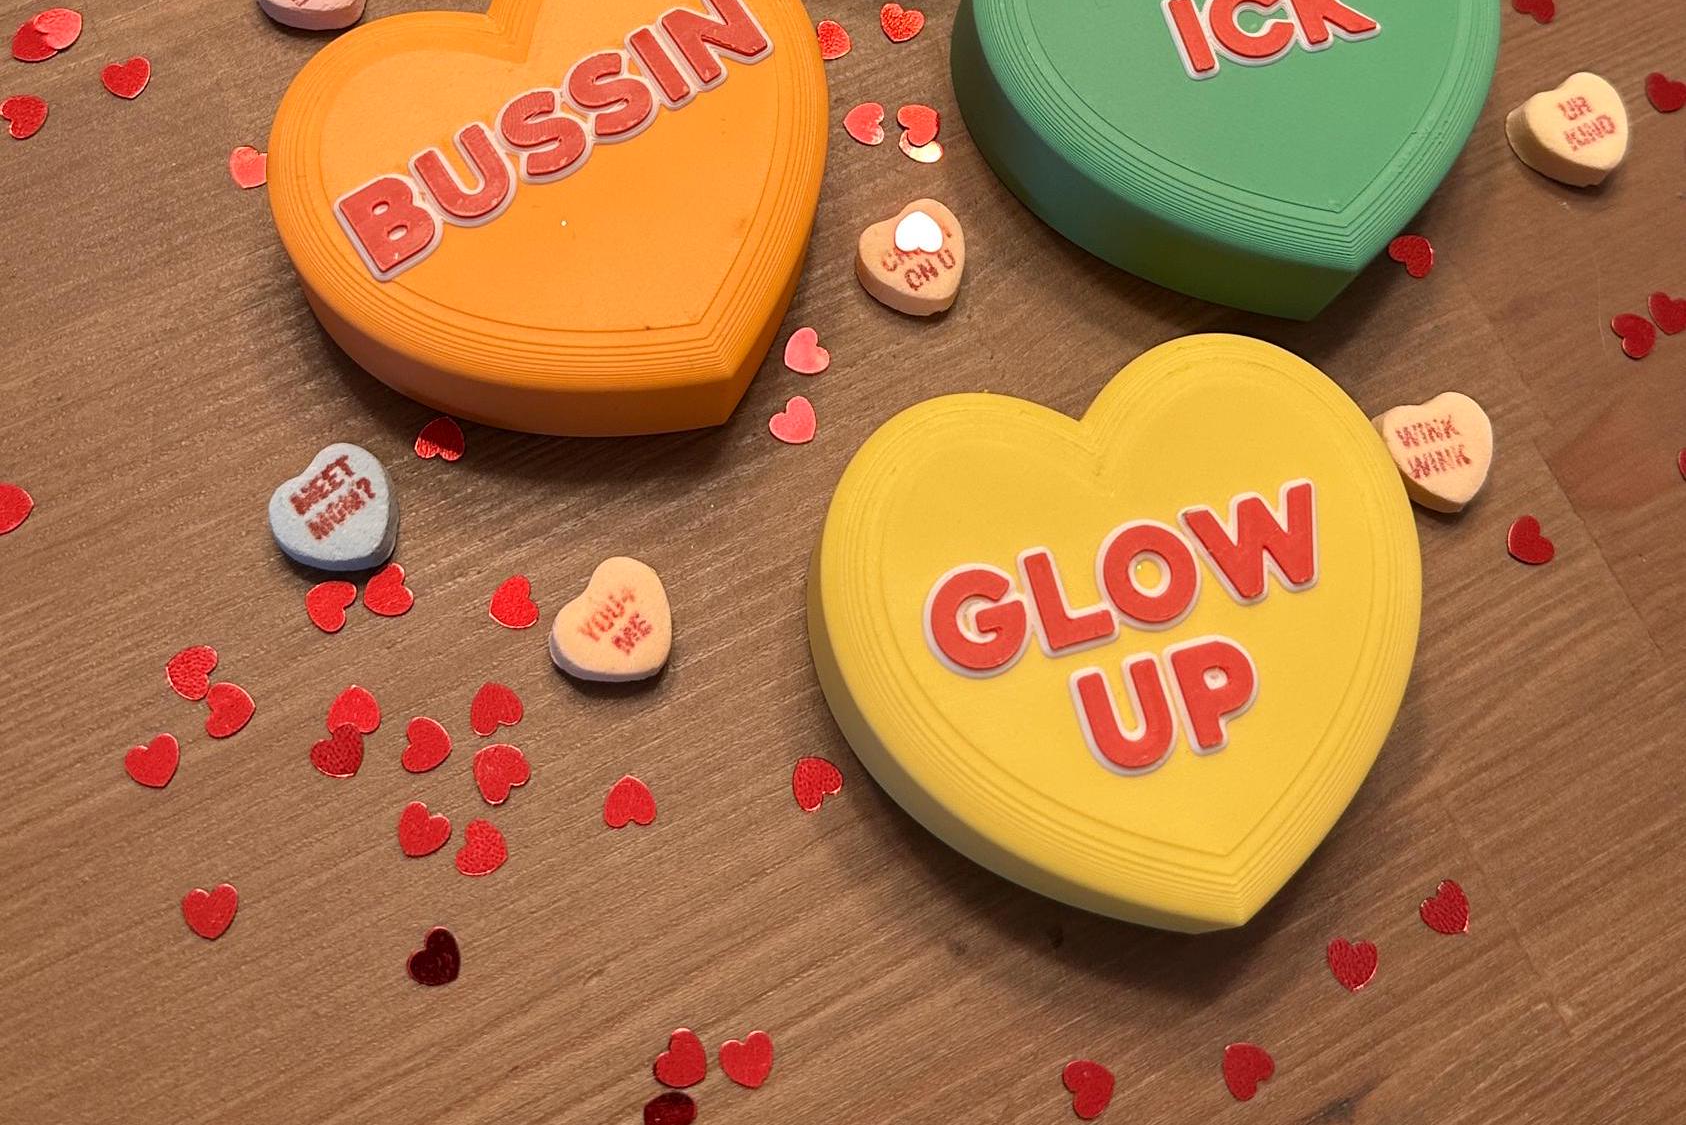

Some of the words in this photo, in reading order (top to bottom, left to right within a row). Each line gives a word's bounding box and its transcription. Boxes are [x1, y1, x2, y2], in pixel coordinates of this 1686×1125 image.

[1395, 415, 1461, 447] WINK
[289, 455, 355, 515] MEET
[1408, 444, 1471, 480] WINK
[924, 479, 1320, 678] GLOW
[1070, 636, 1260, 775] UP
